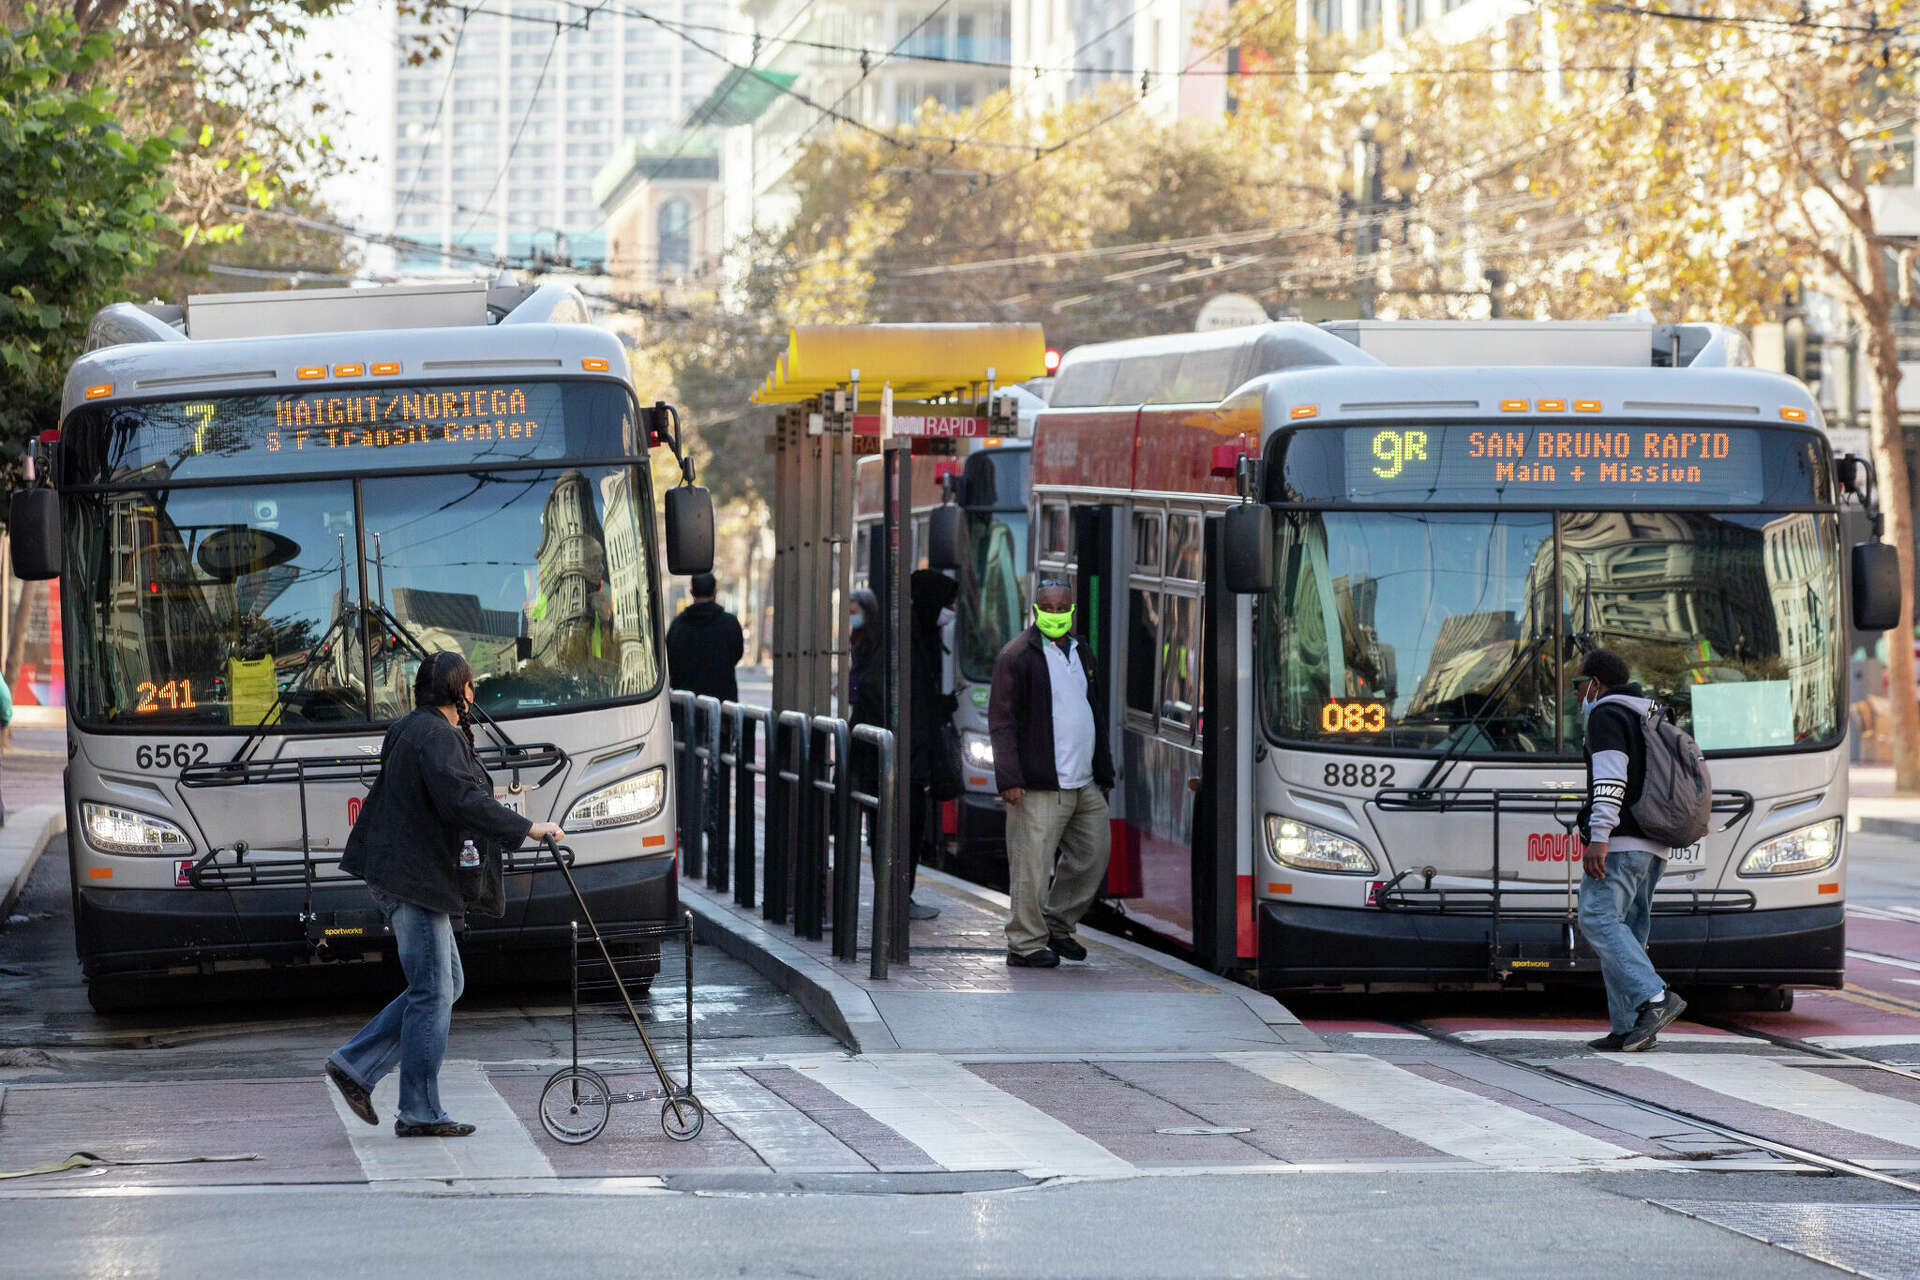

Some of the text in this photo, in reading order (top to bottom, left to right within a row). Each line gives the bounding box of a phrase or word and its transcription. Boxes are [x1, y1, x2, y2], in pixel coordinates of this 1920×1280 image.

[275, 388, 526, 427] HAIGHT/NORIEGA
[185, 404, 214, 452] 7
[266, 420, 538, 452] S F Transit Center
[926, 416, 977, 437] RAPID
[1469, 432, 1730, 459] SAN BRUNO RAPID
[1496, 461, 1555, 482] Main
[1570, 467, 1586, 481] +
[136, 678, 196, 712] 241
[1322, 703, 1385, 732] 083
[136, 742, 209, 769] 6562
[1324, 763, 1395, 787] 8882
[324, 927, 363, 936] sportworks
